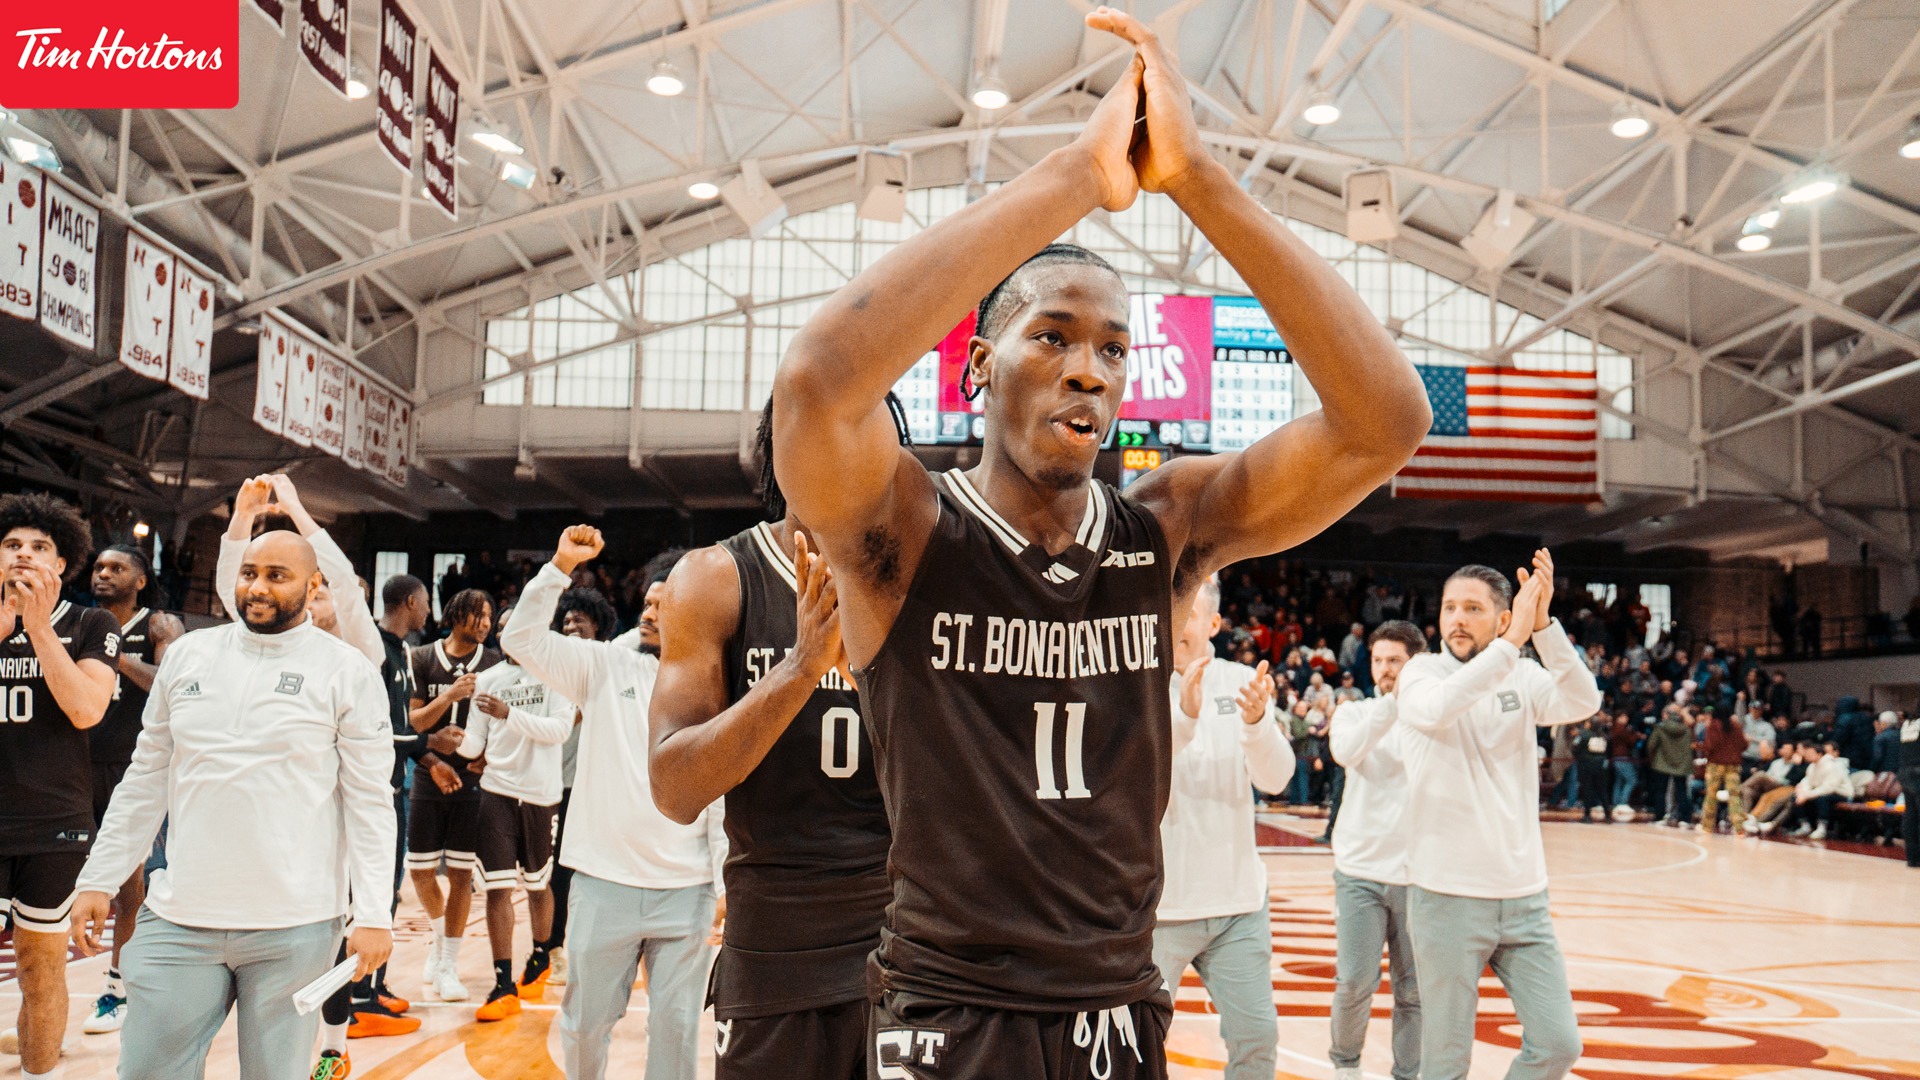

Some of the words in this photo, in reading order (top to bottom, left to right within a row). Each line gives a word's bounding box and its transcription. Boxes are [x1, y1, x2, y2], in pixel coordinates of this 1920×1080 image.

[49, 196, 95, 253] MAAC
[47, 254, 61, 277] 9
[128, 343, 163, 369] 984
[176, 362, 206, 390] 985
[925, 367, 932, 379] 2
[912, 398, 919, 409] 2
[1159, 422, 1182, 444] 86
[1100, 549, 1156, 568] A10
[931, 612, 975, 672] ST.
[983, 613, 1159, 679] BONAVENTURE
[0, 657, 44, 678] NAVEN
[275, 671, 304, 695] B
[1214, 695, 1237, 715] B
[1497, 690, 1521, 712] B
[821, 707, 860, 778] 0
[1034, 702, 1092, 799] 11
